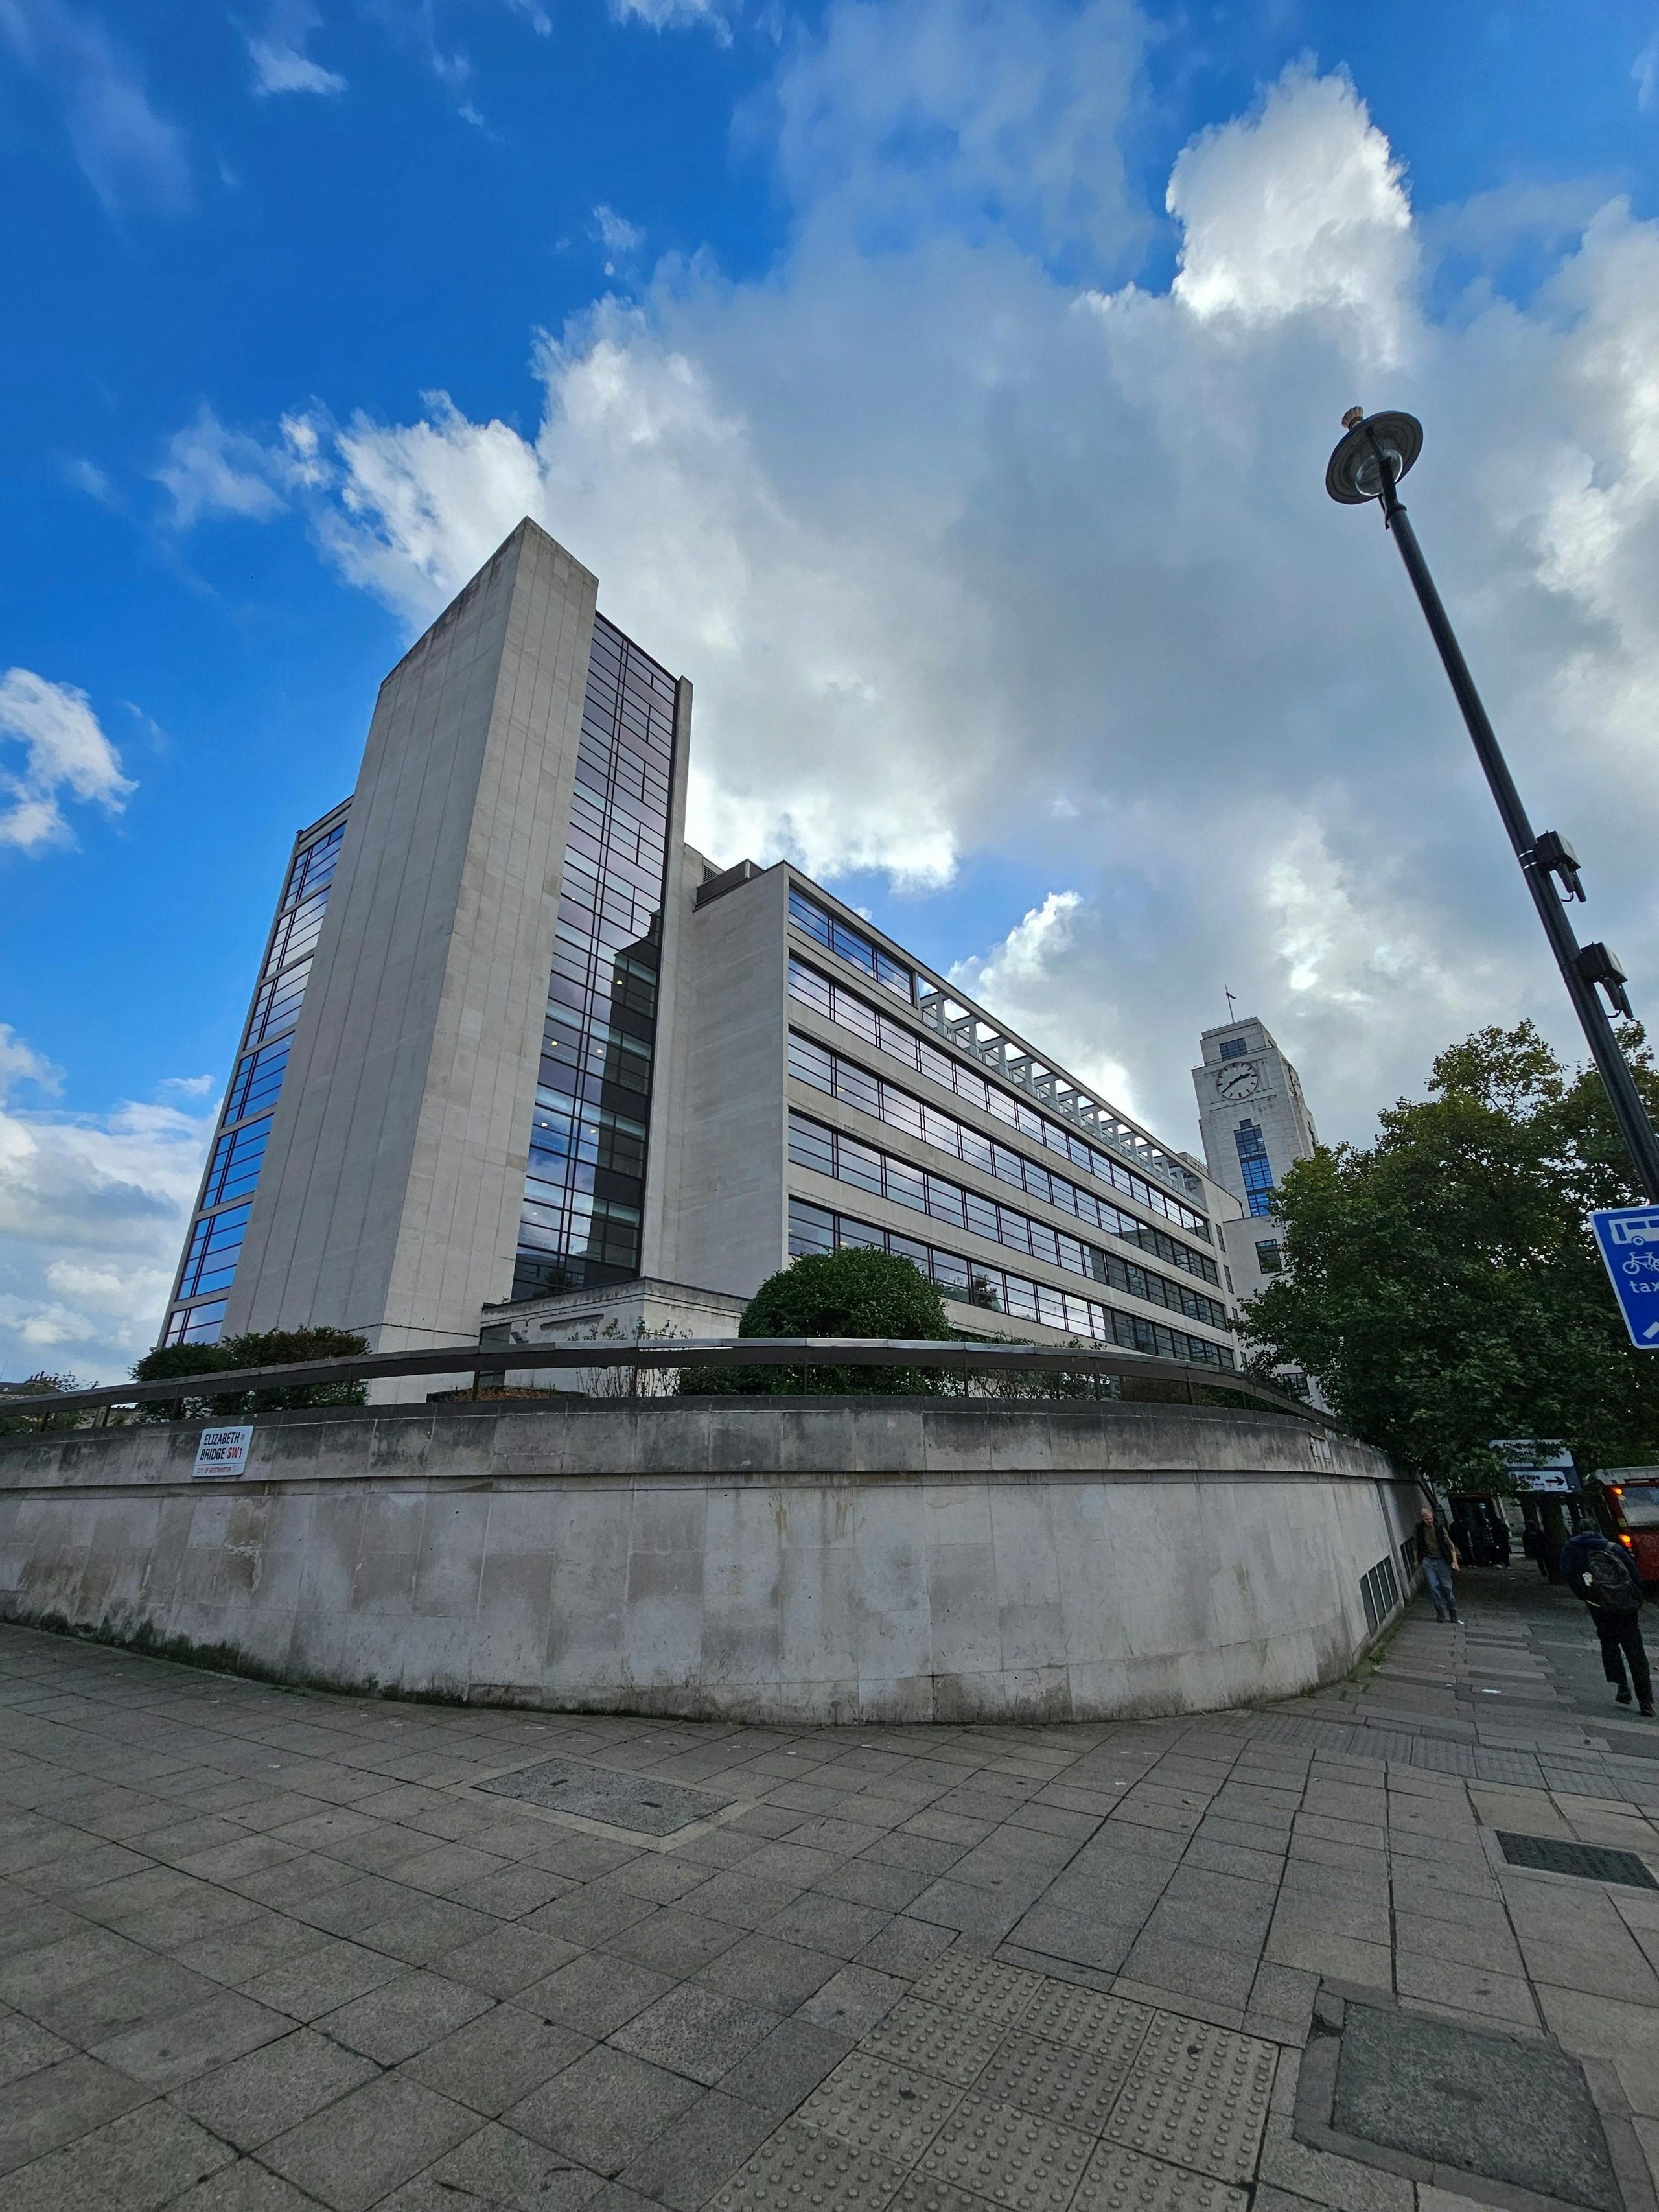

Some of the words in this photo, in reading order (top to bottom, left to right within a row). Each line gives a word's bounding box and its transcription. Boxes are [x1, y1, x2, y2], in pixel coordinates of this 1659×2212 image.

[203, 1432, 240, 1445] ELIZABETH
[200, 1448, 226, 1460] BRIDGE
[227, 1447, 243, 1459] SW1
